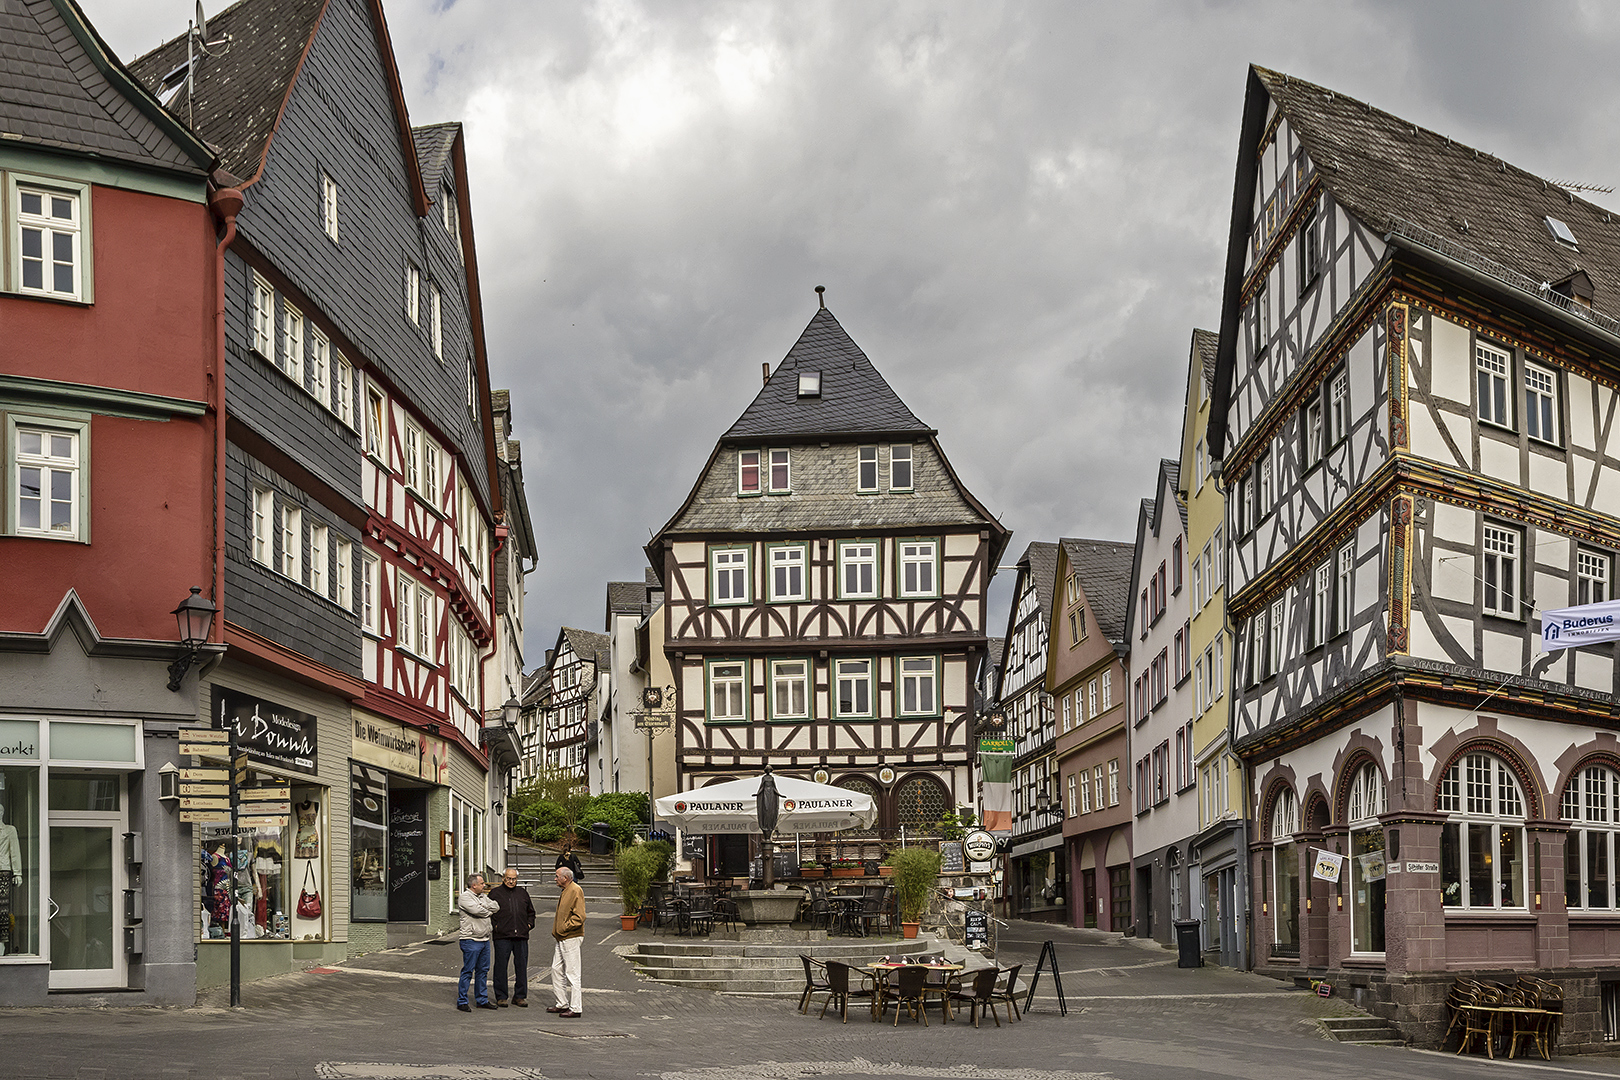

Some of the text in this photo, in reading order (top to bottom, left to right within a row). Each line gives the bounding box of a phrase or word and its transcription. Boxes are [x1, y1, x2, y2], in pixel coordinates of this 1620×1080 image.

[1563, 615, 1613, 629] Buderus
[1568, 628, 1610, 637] IMMOBILIEN
[251, 703, 314, 755] Donna
[355, 720, 417, 756] Die Weinwirtschaft
[0, 740, 35, 755] arkt
[690, 802, 744, 811] PAULANER
[799, 799, 853, 809] PAULANER
